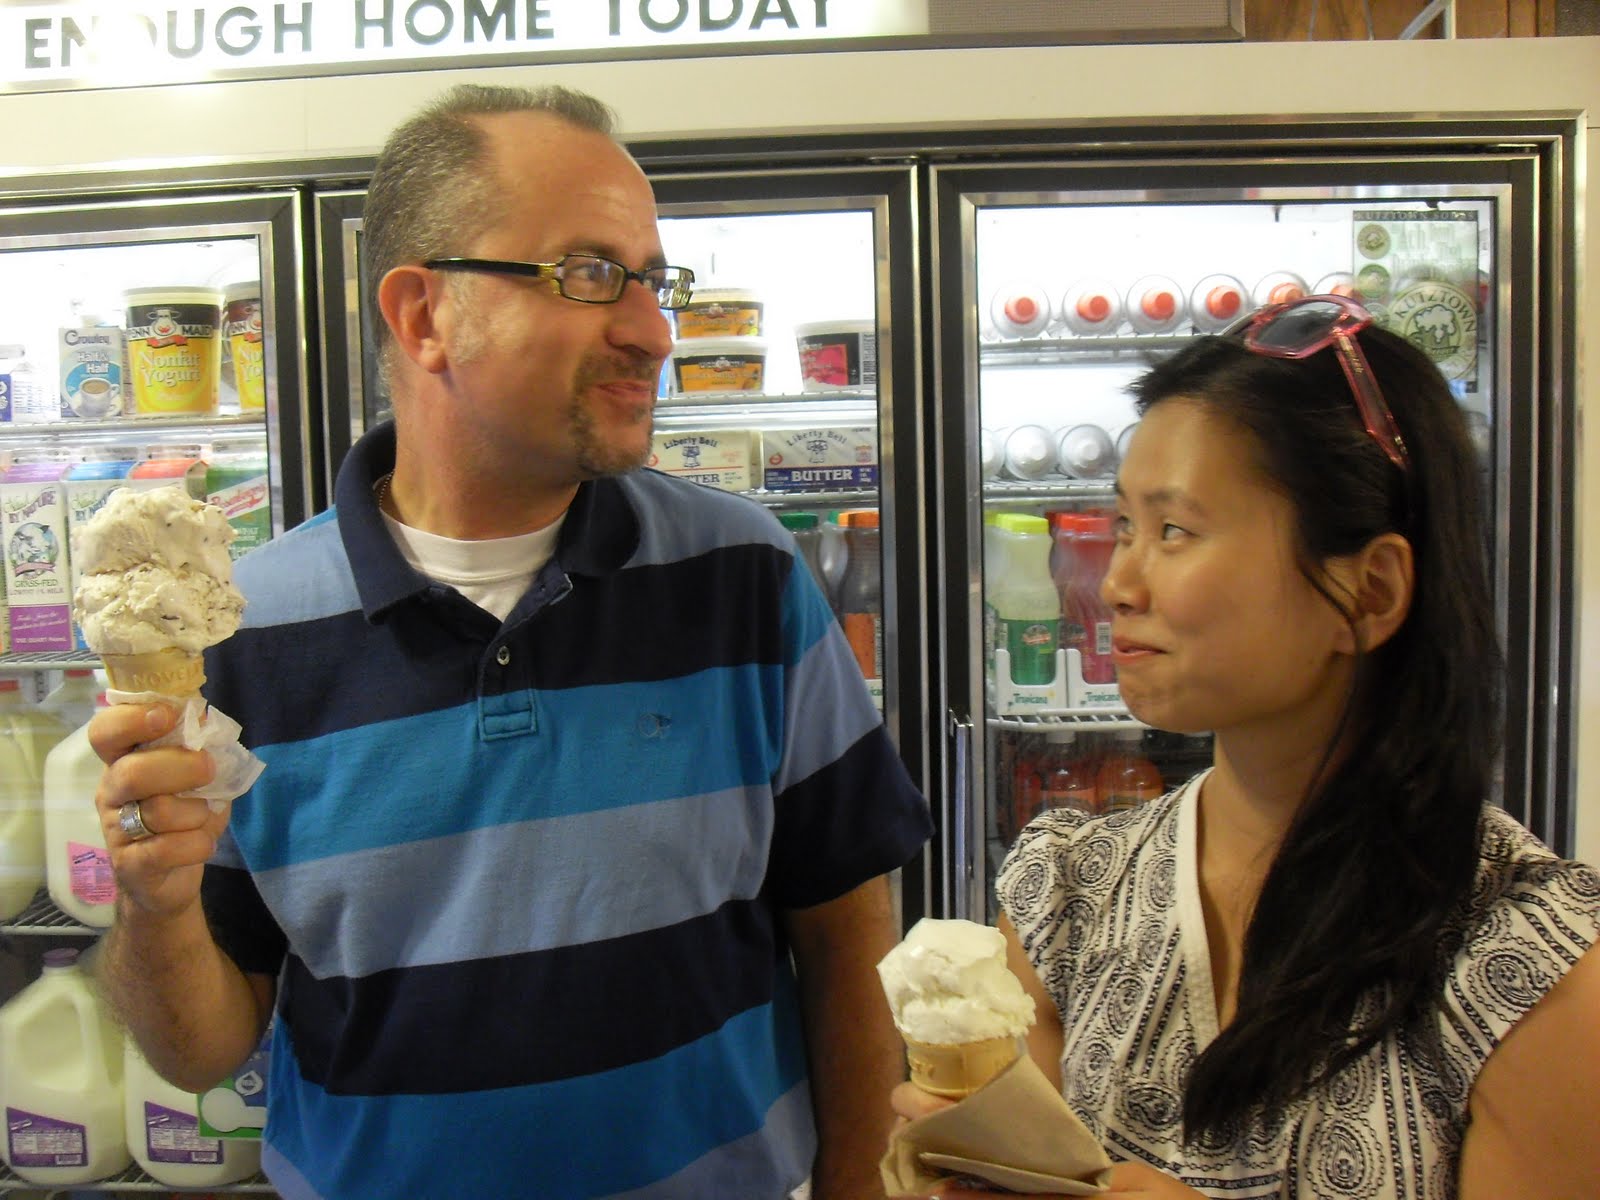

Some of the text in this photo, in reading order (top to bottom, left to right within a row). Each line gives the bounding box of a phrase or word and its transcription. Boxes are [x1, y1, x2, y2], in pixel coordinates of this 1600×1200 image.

[25, 2, 312, 69] ENUGH
[355, 0, 554, 48] HOME
[1395, 290, 1477, 333] KUTZTOWN
[86, 362, 109, 374] Half
[139, 366, 200, 387] Yogurt
[664, 437, 718, 449] Liberty Bell
[786, 431, 848, 447] Liberty Bell
[791, 470, 853, 482] BUTTER
